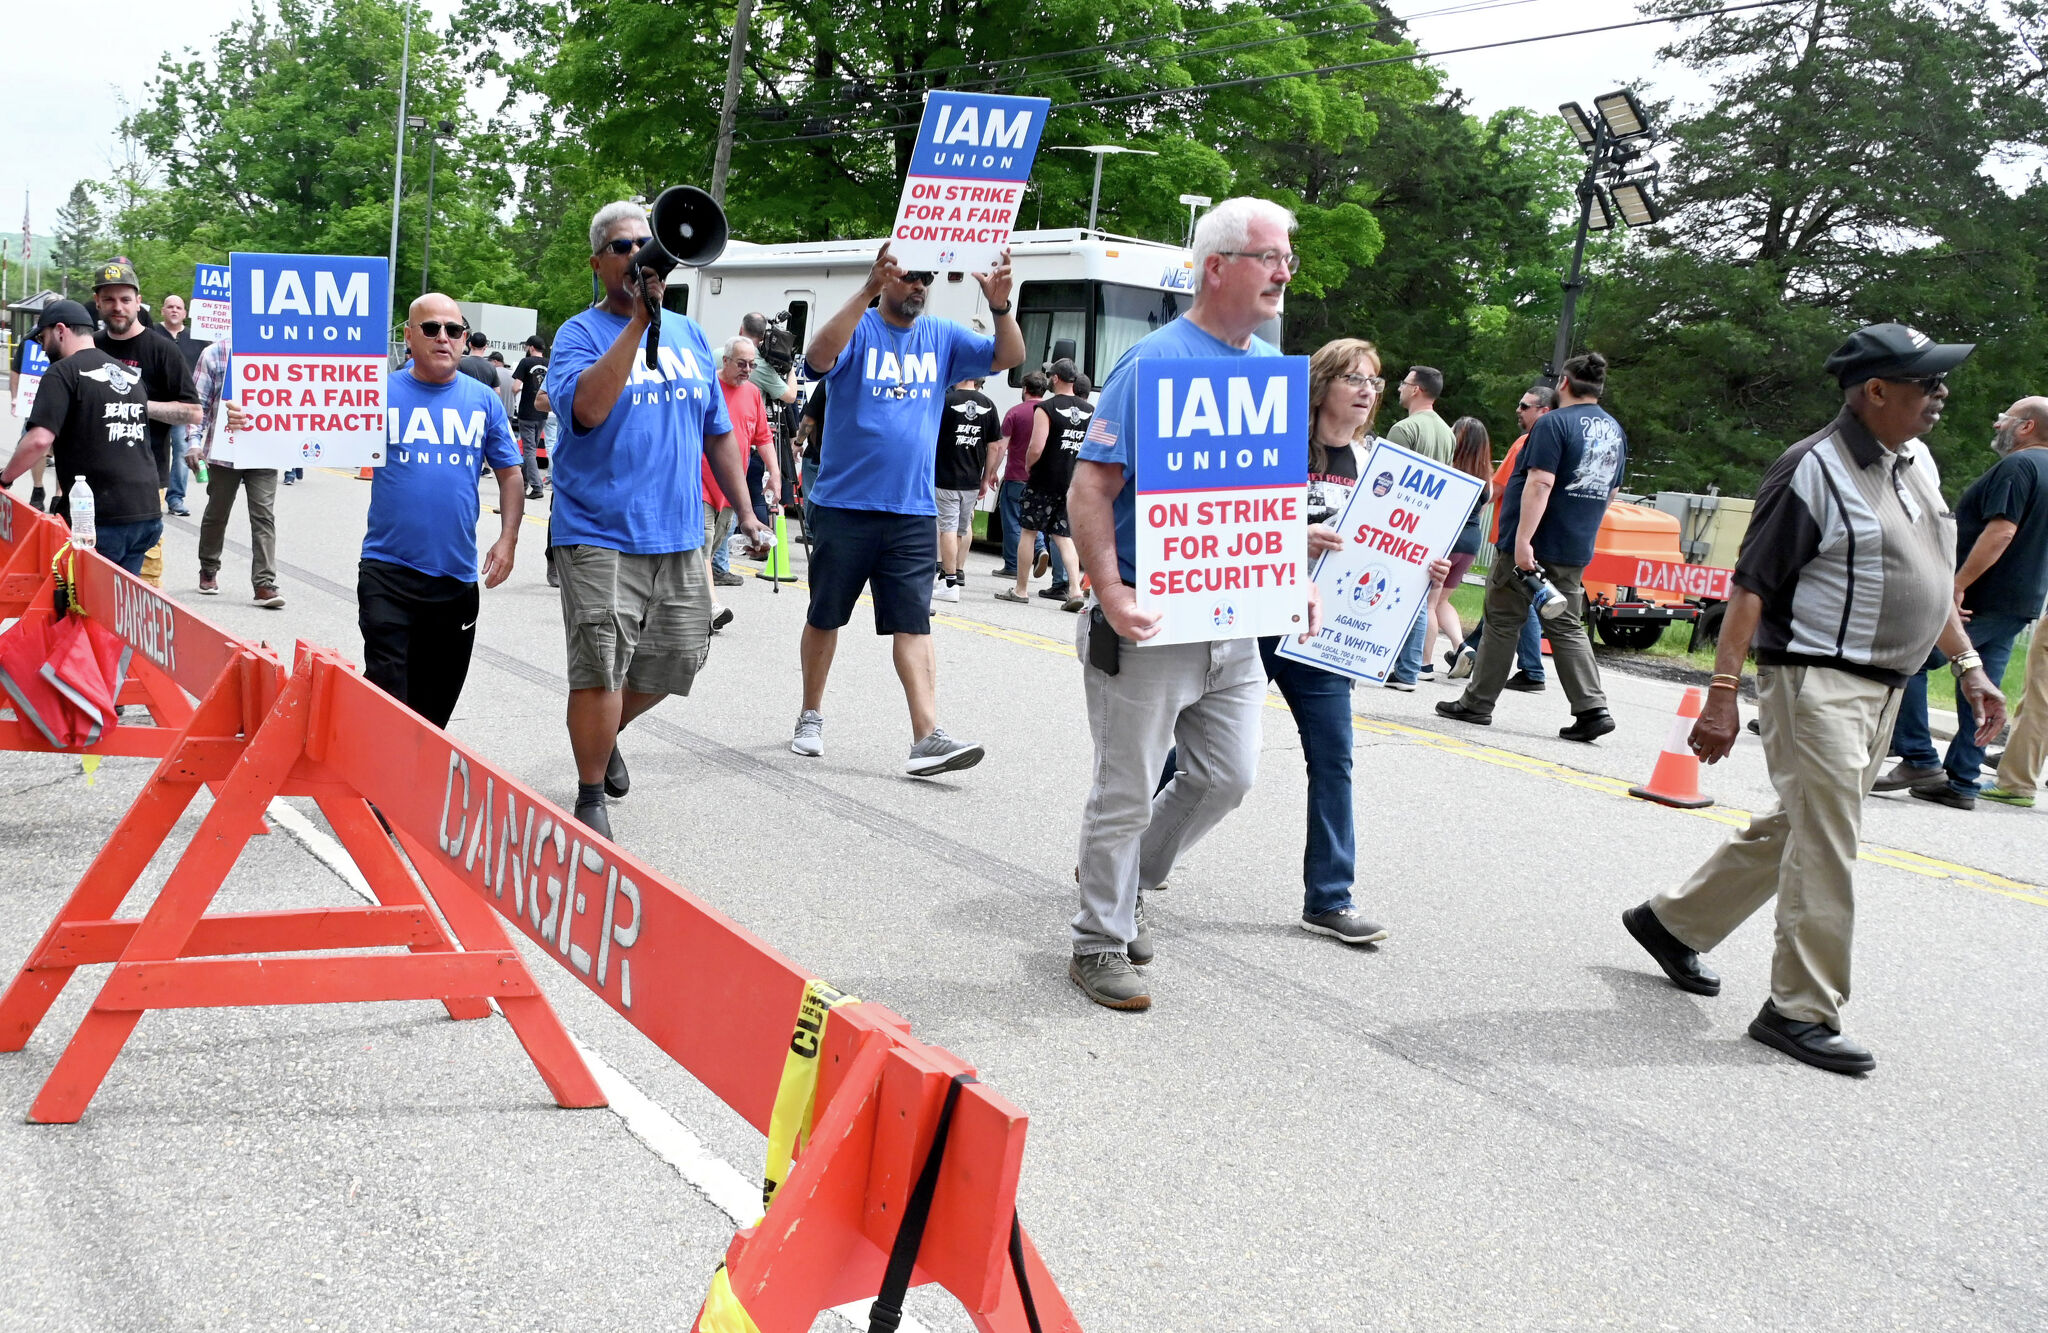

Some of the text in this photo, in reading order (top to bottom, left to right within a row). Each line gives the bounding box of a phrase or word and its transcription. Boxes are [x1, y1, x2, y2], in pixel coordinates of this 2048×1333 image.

[932, 105, 1033, 149] IAM
[934, 152, 1013, 169] UNION
[912, 184, 1017, 204] ON STRIKE
[904, 205, 1011, 224] FOR A FAIR
[896, 225, 1009, 244] CONTRACT!
[203, 289, 231, 297] UNIO
[251, 269, 369, 316] IAM
[260, 325, 361, 341] UNION
[243, 363, 379, 382] ON STRIKE
[866, 347, 937, 385] IAM
[241, 389, 379, 407] FOR A FAIR
[633, 387, 702, 405] UNION
[1158, 376, 1288, 438] IAM
[240, 413, 383, 432] CONTRACT!
[388, 407, 487, 448] IAM
[400, 451, 474, 467] UNION
[1167, 448, 1279, 471] UNION
[1399, 465, 1447, 500] IAM
[1397, 492, 1431, 510] UNION
[1148, 497, 1297, 528] ON STRIKE
[1389, 508, 1420, 534] ON
[1164, 531, 1283, 561] FOR JOB
[1354, 524, 1429, 566] STRIKE!
[1149, 562, 1296, 595] SECURITY!
[113, 573, 177, 672] DANGER
[1335, 614, 1372, 632] AGAINST
[1322, 645, 1339, 655] LOCAL
[1334, 632, 1342, 643] &
[1344, 635, 1391, 658] WHITNEY
[1320, 652, 1346, 663] DISTRICT
[439, 749, 642, 1009] DANGER
